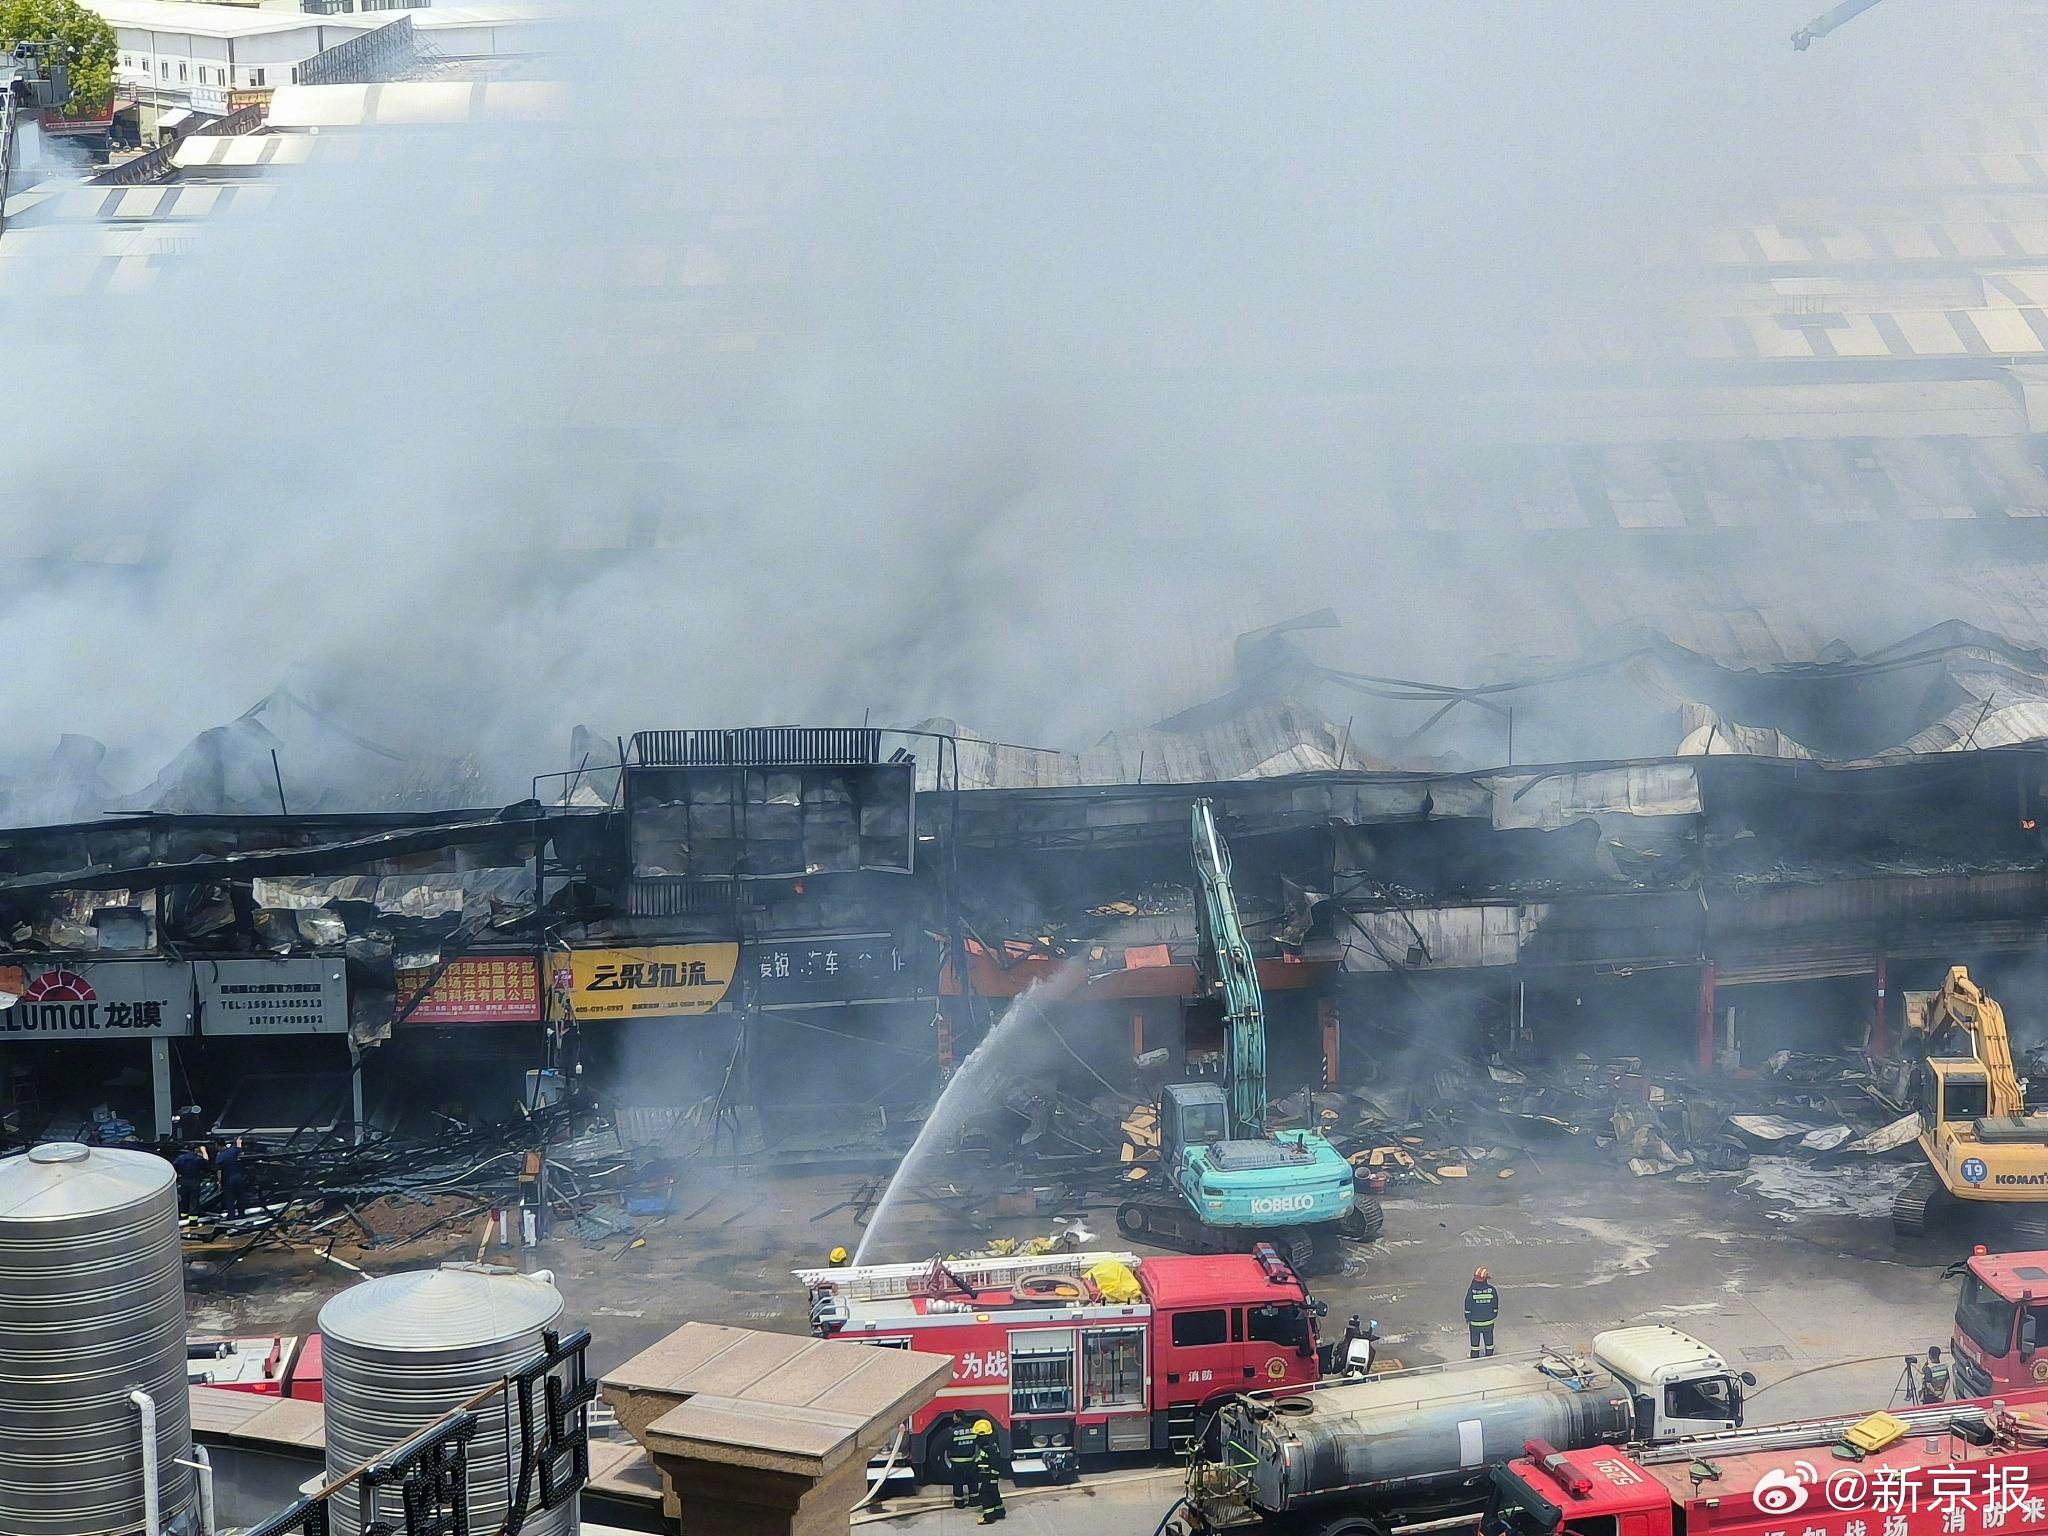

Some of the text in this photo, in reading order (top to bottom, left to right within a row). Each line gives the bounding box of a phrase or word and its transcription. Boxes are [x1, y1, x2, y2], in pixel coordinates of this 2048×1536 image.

[103, 1000, 163, 1029] 龙膜
[1964, 1164, 1984, 1176] 19
[1995, 1173, 2048, 1185] KOMAT
[1251, 1194, 1315, 1214] KOBELCO
[952, 1350, 1008, 1380] 为战
[1188, 1370, 1214, 1383] 消防
[243, 1328, 598, 1536] 酒店
[1592, 1460, 1635, 1486] 5290
